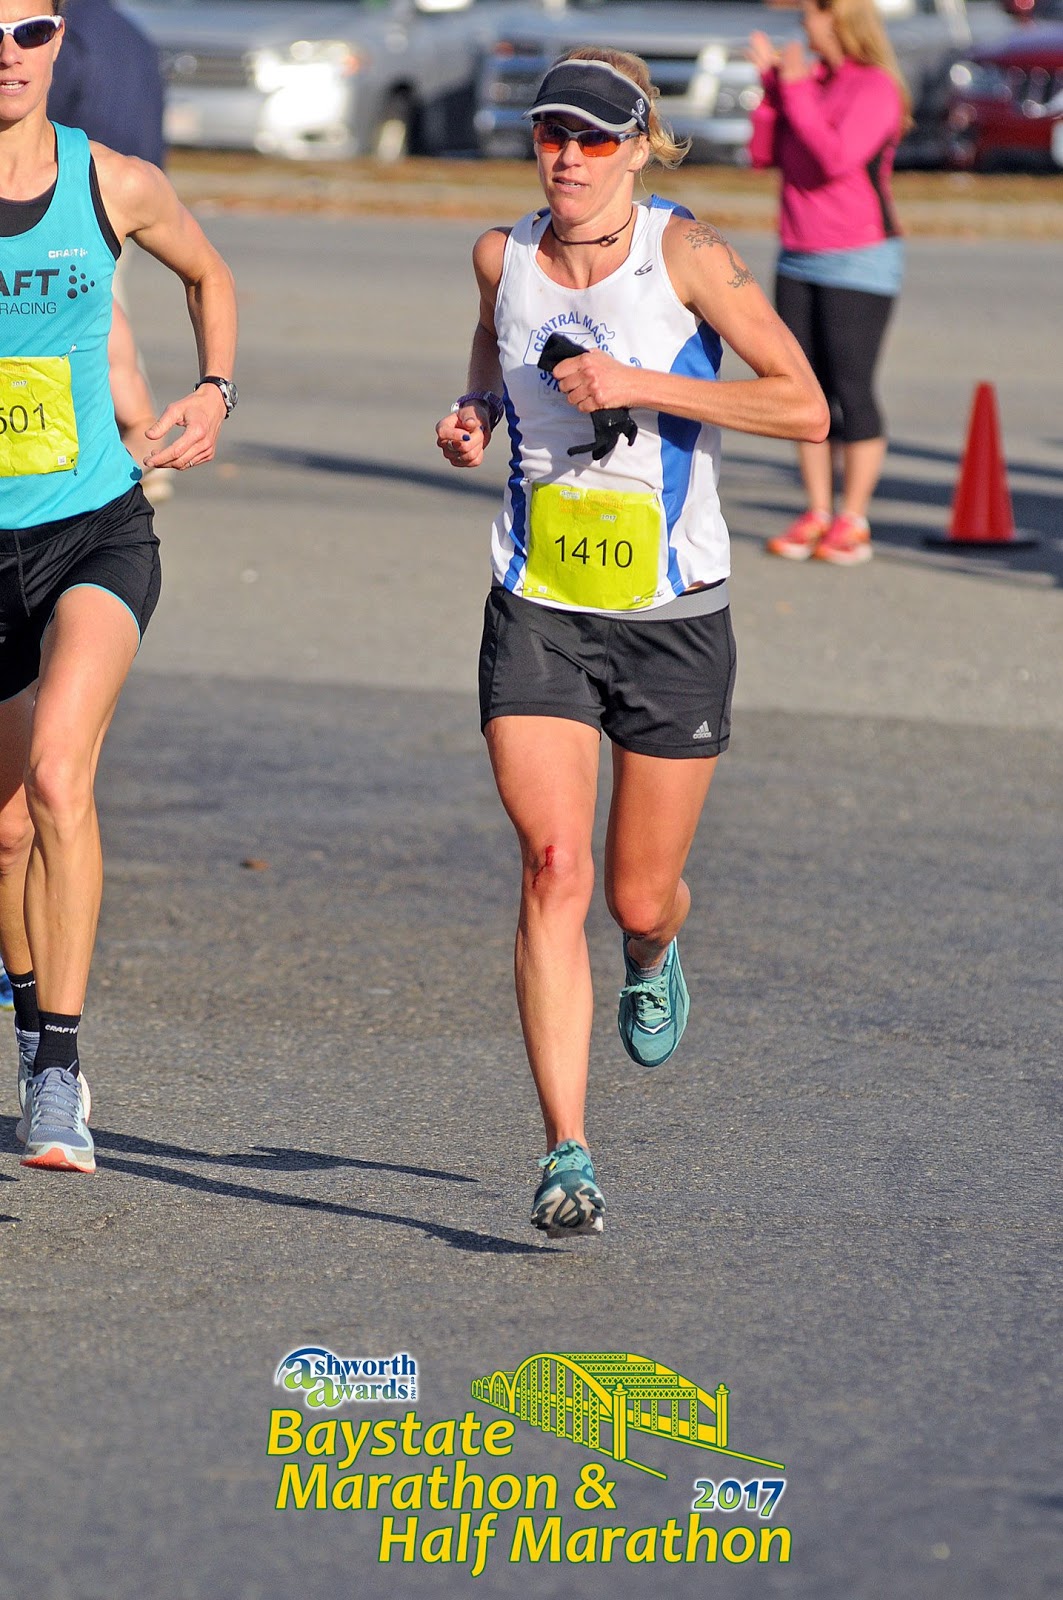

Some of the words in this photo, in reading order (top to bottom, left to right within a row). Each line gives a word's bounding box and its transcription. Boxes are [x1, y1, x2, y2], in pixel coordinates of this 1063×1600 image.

[48, 248, 79, 258] CRAFT
[0, 301, 57, 315] RACING
[534, 311, 581, 352] CENTRAL
[583, 315, 609, 351] MASS
[554, 535, 633, 568] 1410
